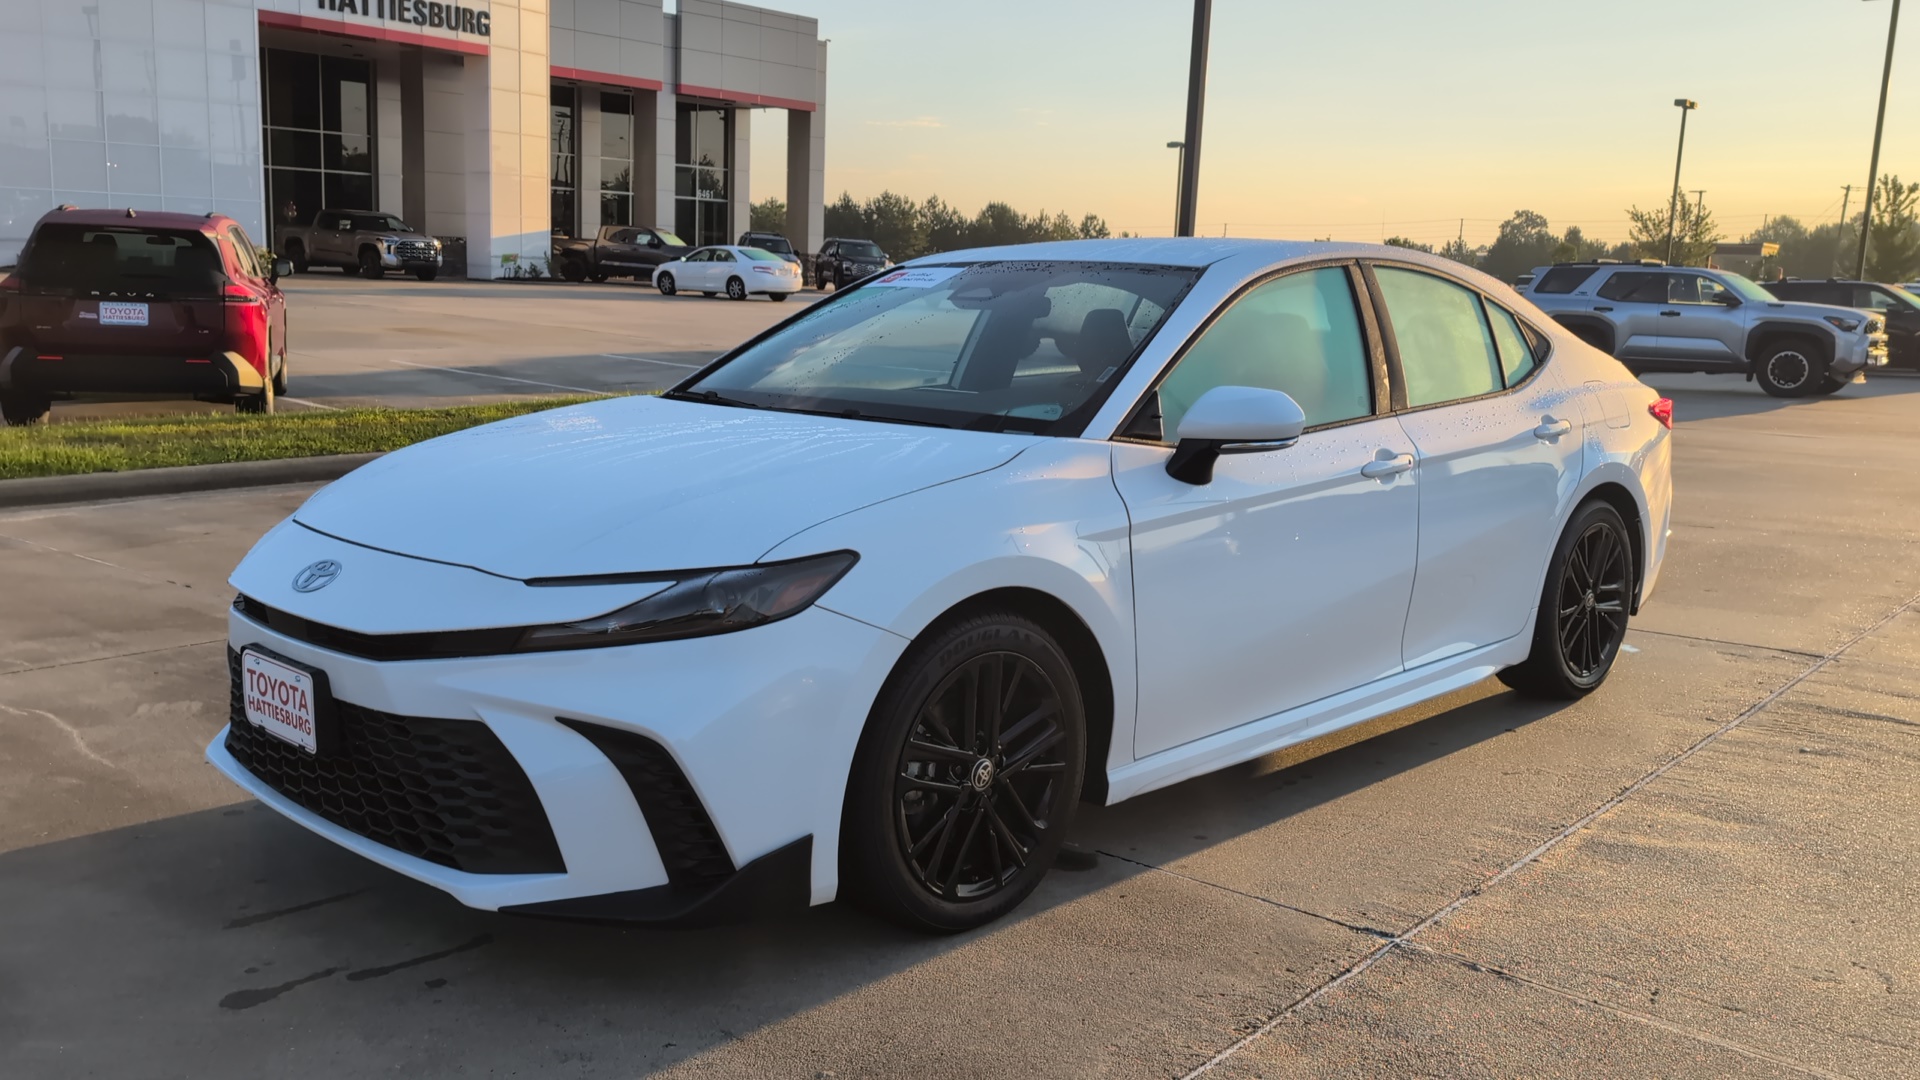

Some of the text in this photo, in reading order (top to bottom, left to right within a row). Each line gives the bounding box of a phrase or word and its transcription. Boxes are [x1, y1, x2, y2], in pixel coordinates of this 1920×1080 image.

[104, 307, 144, 315] TOYOTA
[247, 668, 309, 716] TOYOTA
[248, 694, 312, 736] HATTIESBURG
